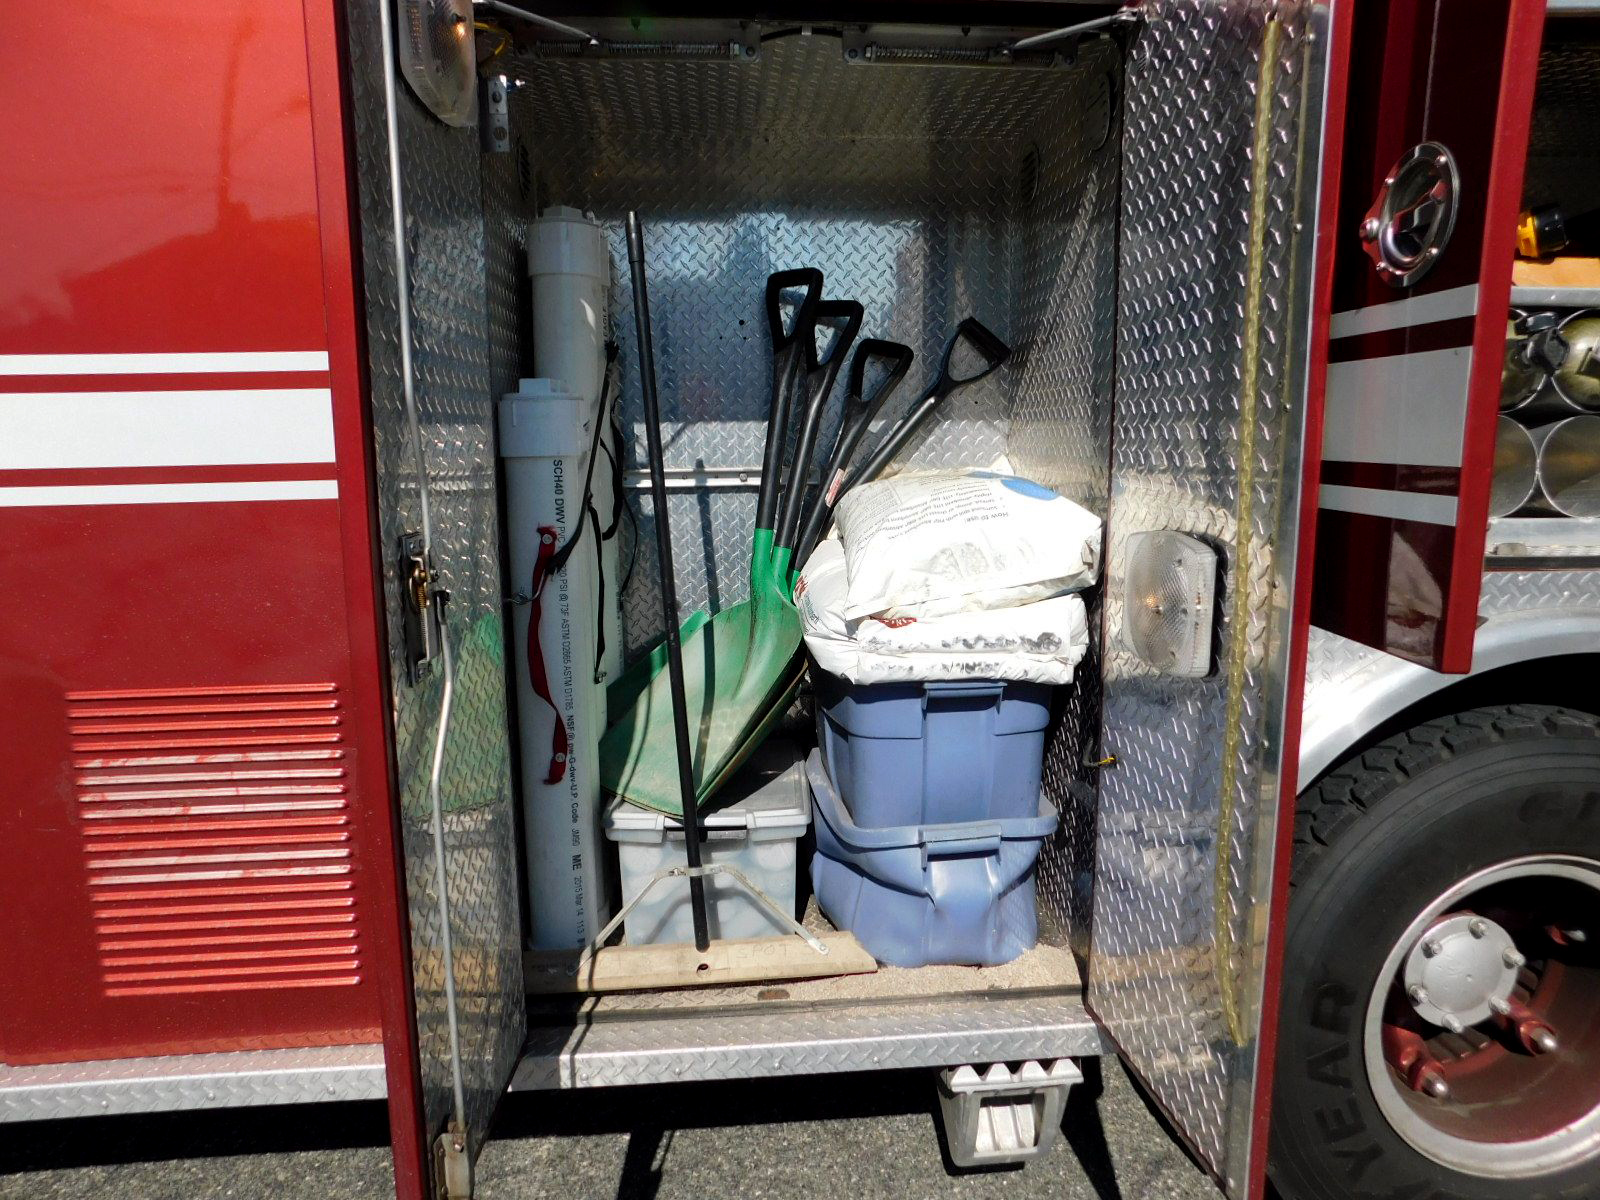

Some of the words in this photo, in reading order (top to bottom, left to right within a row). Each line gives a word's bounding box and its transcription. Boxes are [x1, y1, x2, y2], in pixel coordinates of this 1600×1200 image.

[553, 459, 565, 495] SCH40
[554, 498, 565, 524] DWV
[991, 511, 1009, 520] How
[557, 526, 566, 543] PVC
[559, 579, 569, 592] PSI
[559, 603, 569, 616] 73F
[561, 618, 571, 640] ASTM
[562, 641, 572, 664] D2665
[563, 665, 573, 687] ASTM
[564, 688, 574, 711] D1785
[570, 802, 579, 824] Code
[571, 853, 582, 871] ME
